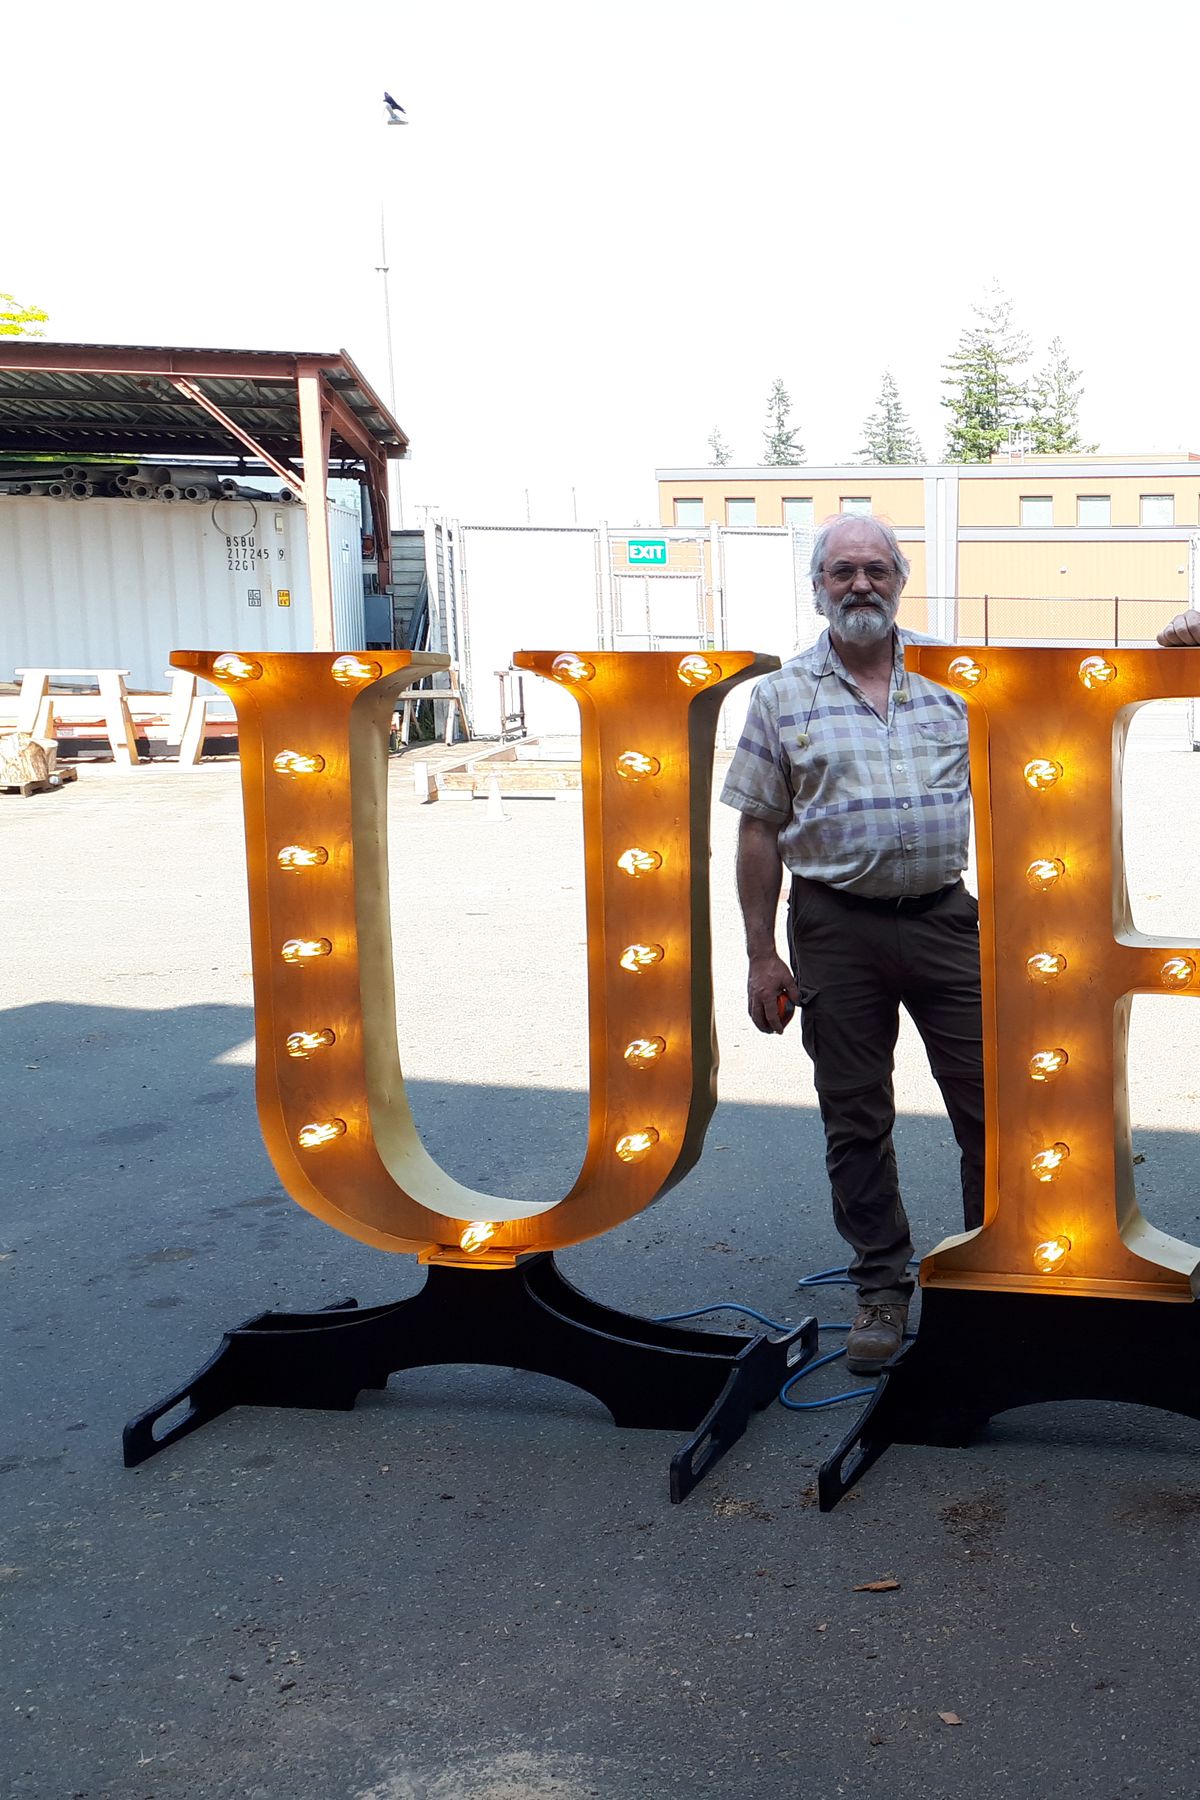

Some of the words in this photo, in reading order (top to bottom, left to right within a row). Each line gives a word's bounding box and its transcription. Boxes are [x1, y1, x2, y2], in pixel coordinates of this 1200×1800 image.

[226, 536, 255, 547] BSBU
[227, 548, 269, 560] 217245
[278, 549, 285, 560] 9
[629, 545, 665, 559] EXIT
[228, 560, 255, 571] 22G1
